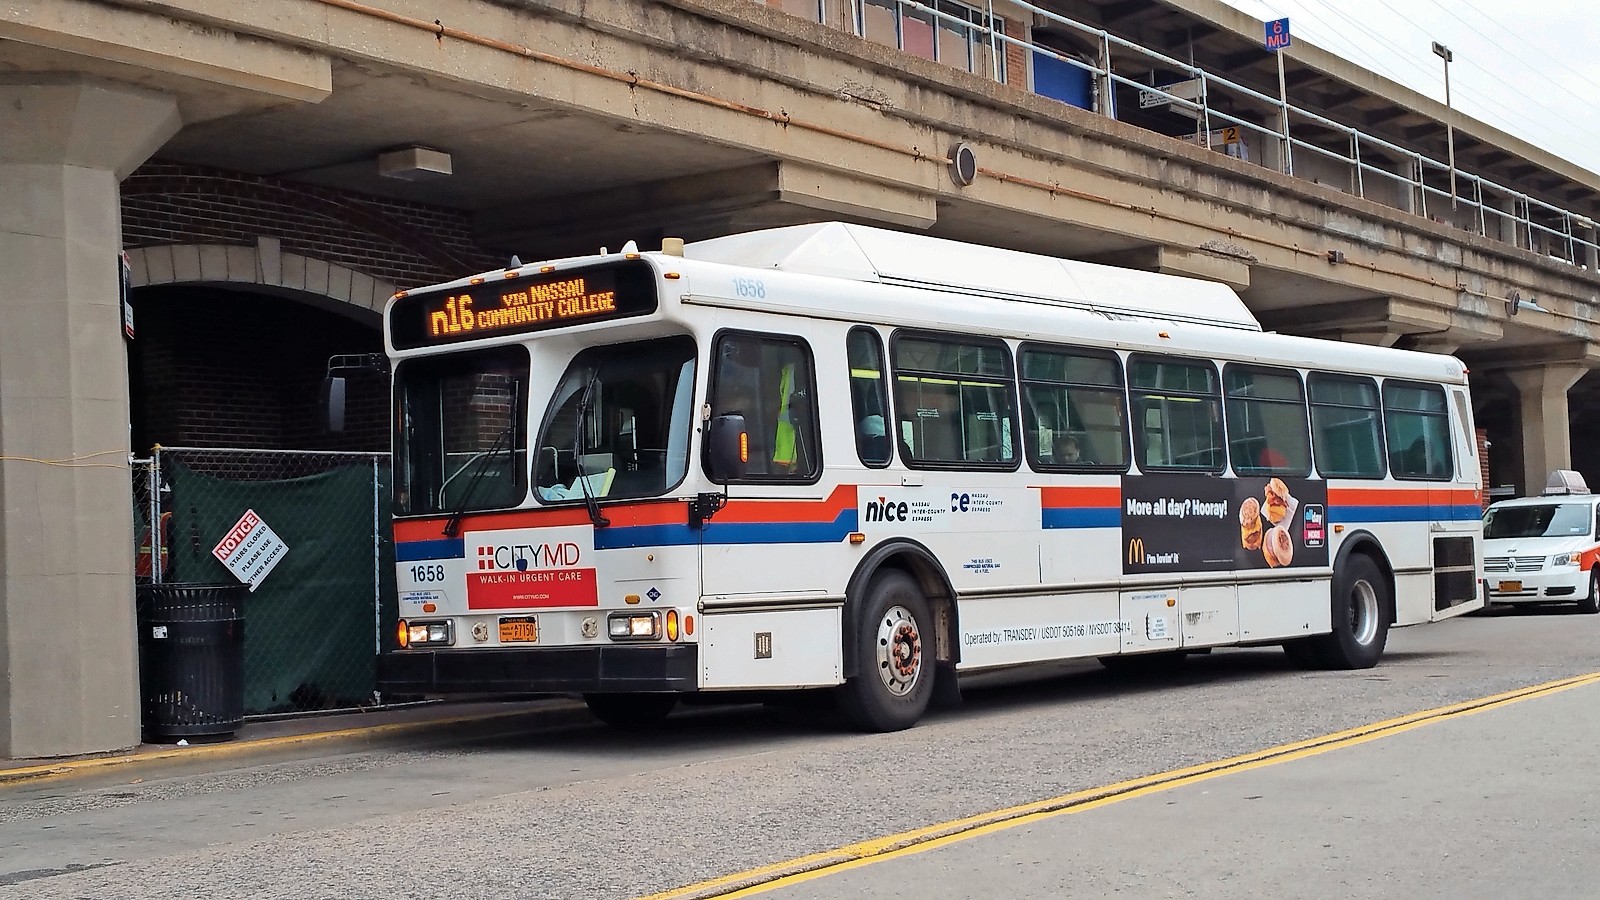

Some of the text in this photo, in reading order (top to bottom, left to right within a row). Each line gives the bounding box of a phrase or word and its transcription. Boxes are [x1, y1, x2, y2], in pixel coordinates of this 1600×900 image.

[1274, 20, 1282, 34] 6
[1267, 33, 1289, 47] MU
[1227, 128, 1236, 141] 2
[732, 277, 766, 299] 1658
[431, 294, 475, 336] n16
[530, 278, 585, 302] NASSAU
[476, 291, 616, 328] COMMUNITY COLLEGE
[865, 496, 909, 522] nice
[1126, 497, 1228, 519] More all day? Hooray!
[216, 514, 258, 559] NOTICE
[229, 525, 267, 568] STAIRS CLOSED
[241, 538, 272, 573] PLEASE USE
[247, 543, 283, 585] OTHER ACCESS
[411, 564, 445, 583] 1658
[480, 571, 582, 584] WALK-IN URGENT CARE
[964, 631, 992, 647] Operated
[1003, 627, 1037, 642] TRANSDEV
[1041, 626, 1062, 640] USDOT
[1089, 622, 1113, 636] NYSDOT
